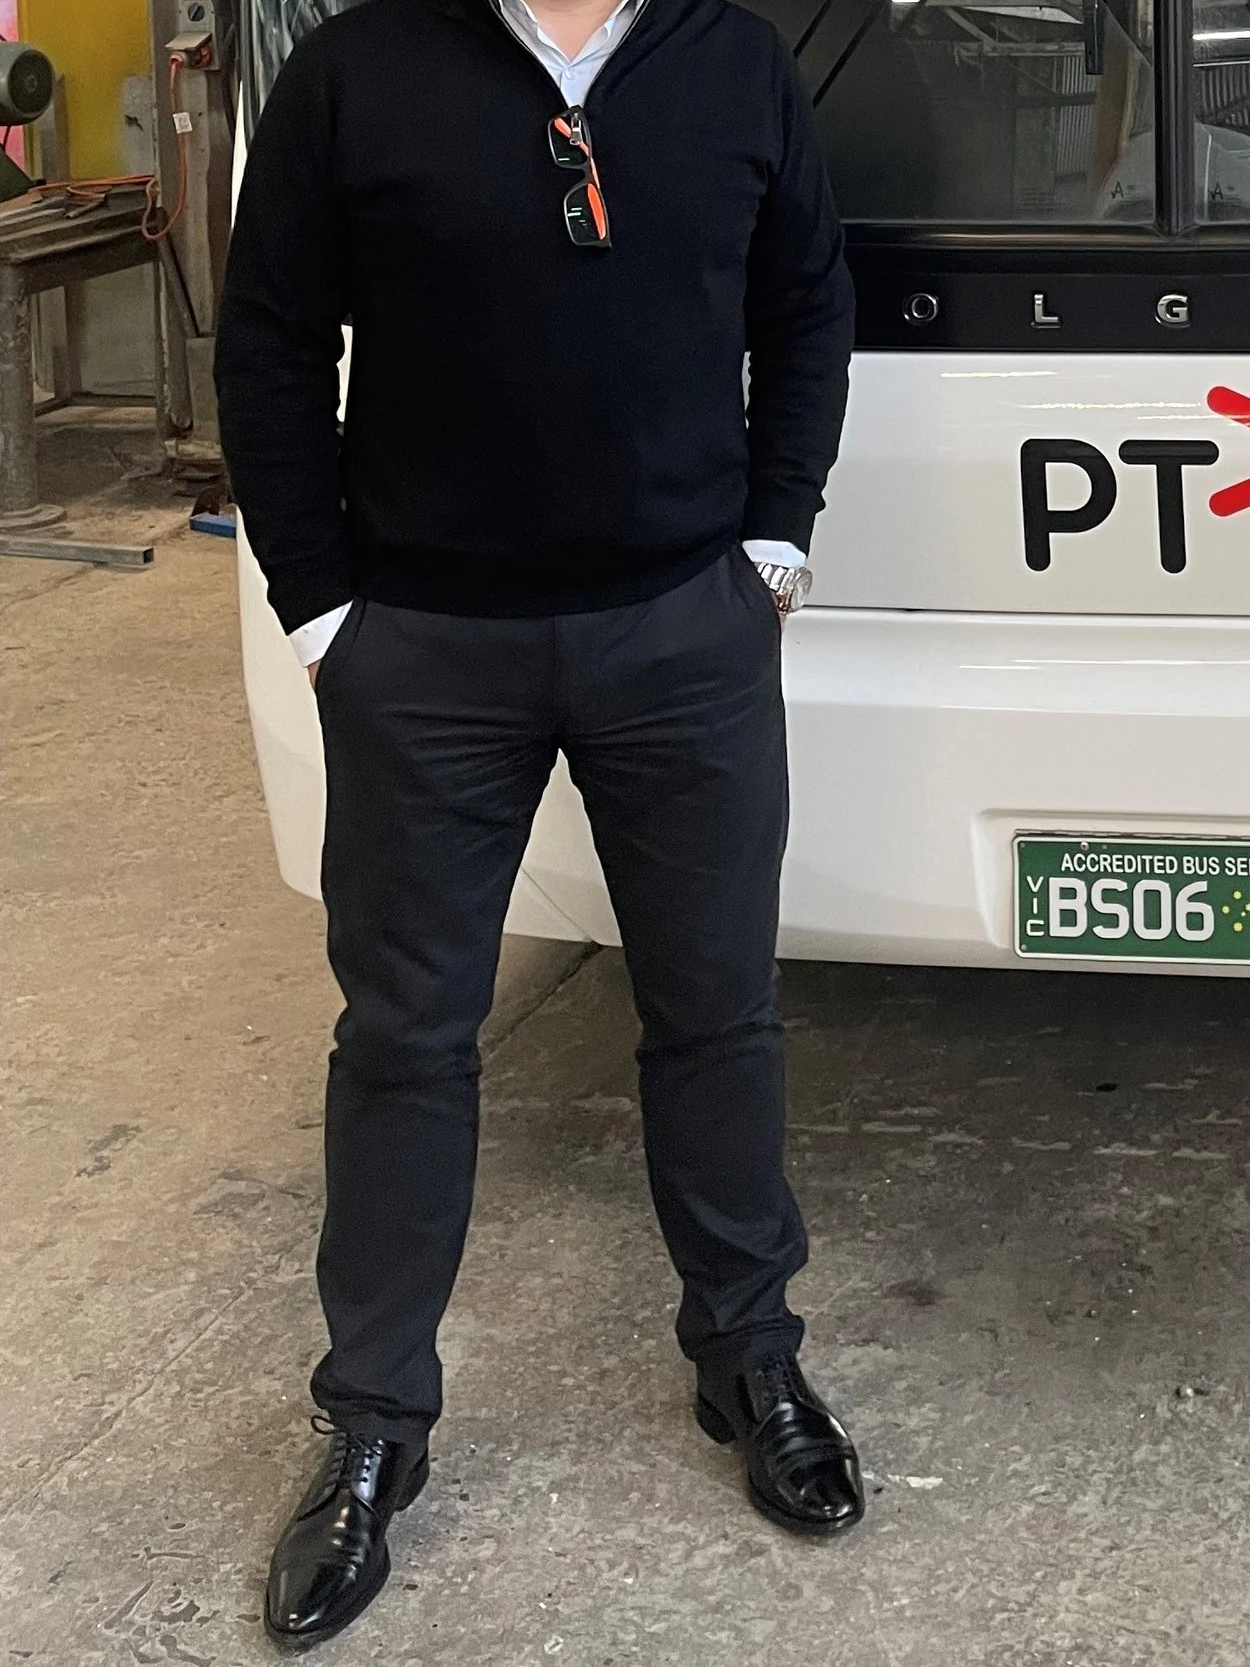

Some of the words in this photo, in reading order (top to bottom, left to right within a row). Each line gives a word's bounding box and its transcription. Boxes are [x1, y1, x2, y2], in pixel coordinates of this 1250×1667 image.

[1020, 438, 1219, 574] PT
[1061, 853, 1178, 875] ACCREDITED
[1183, 857, 1220, 876] BUS
[1049, 877, 1215, 942] BS06
